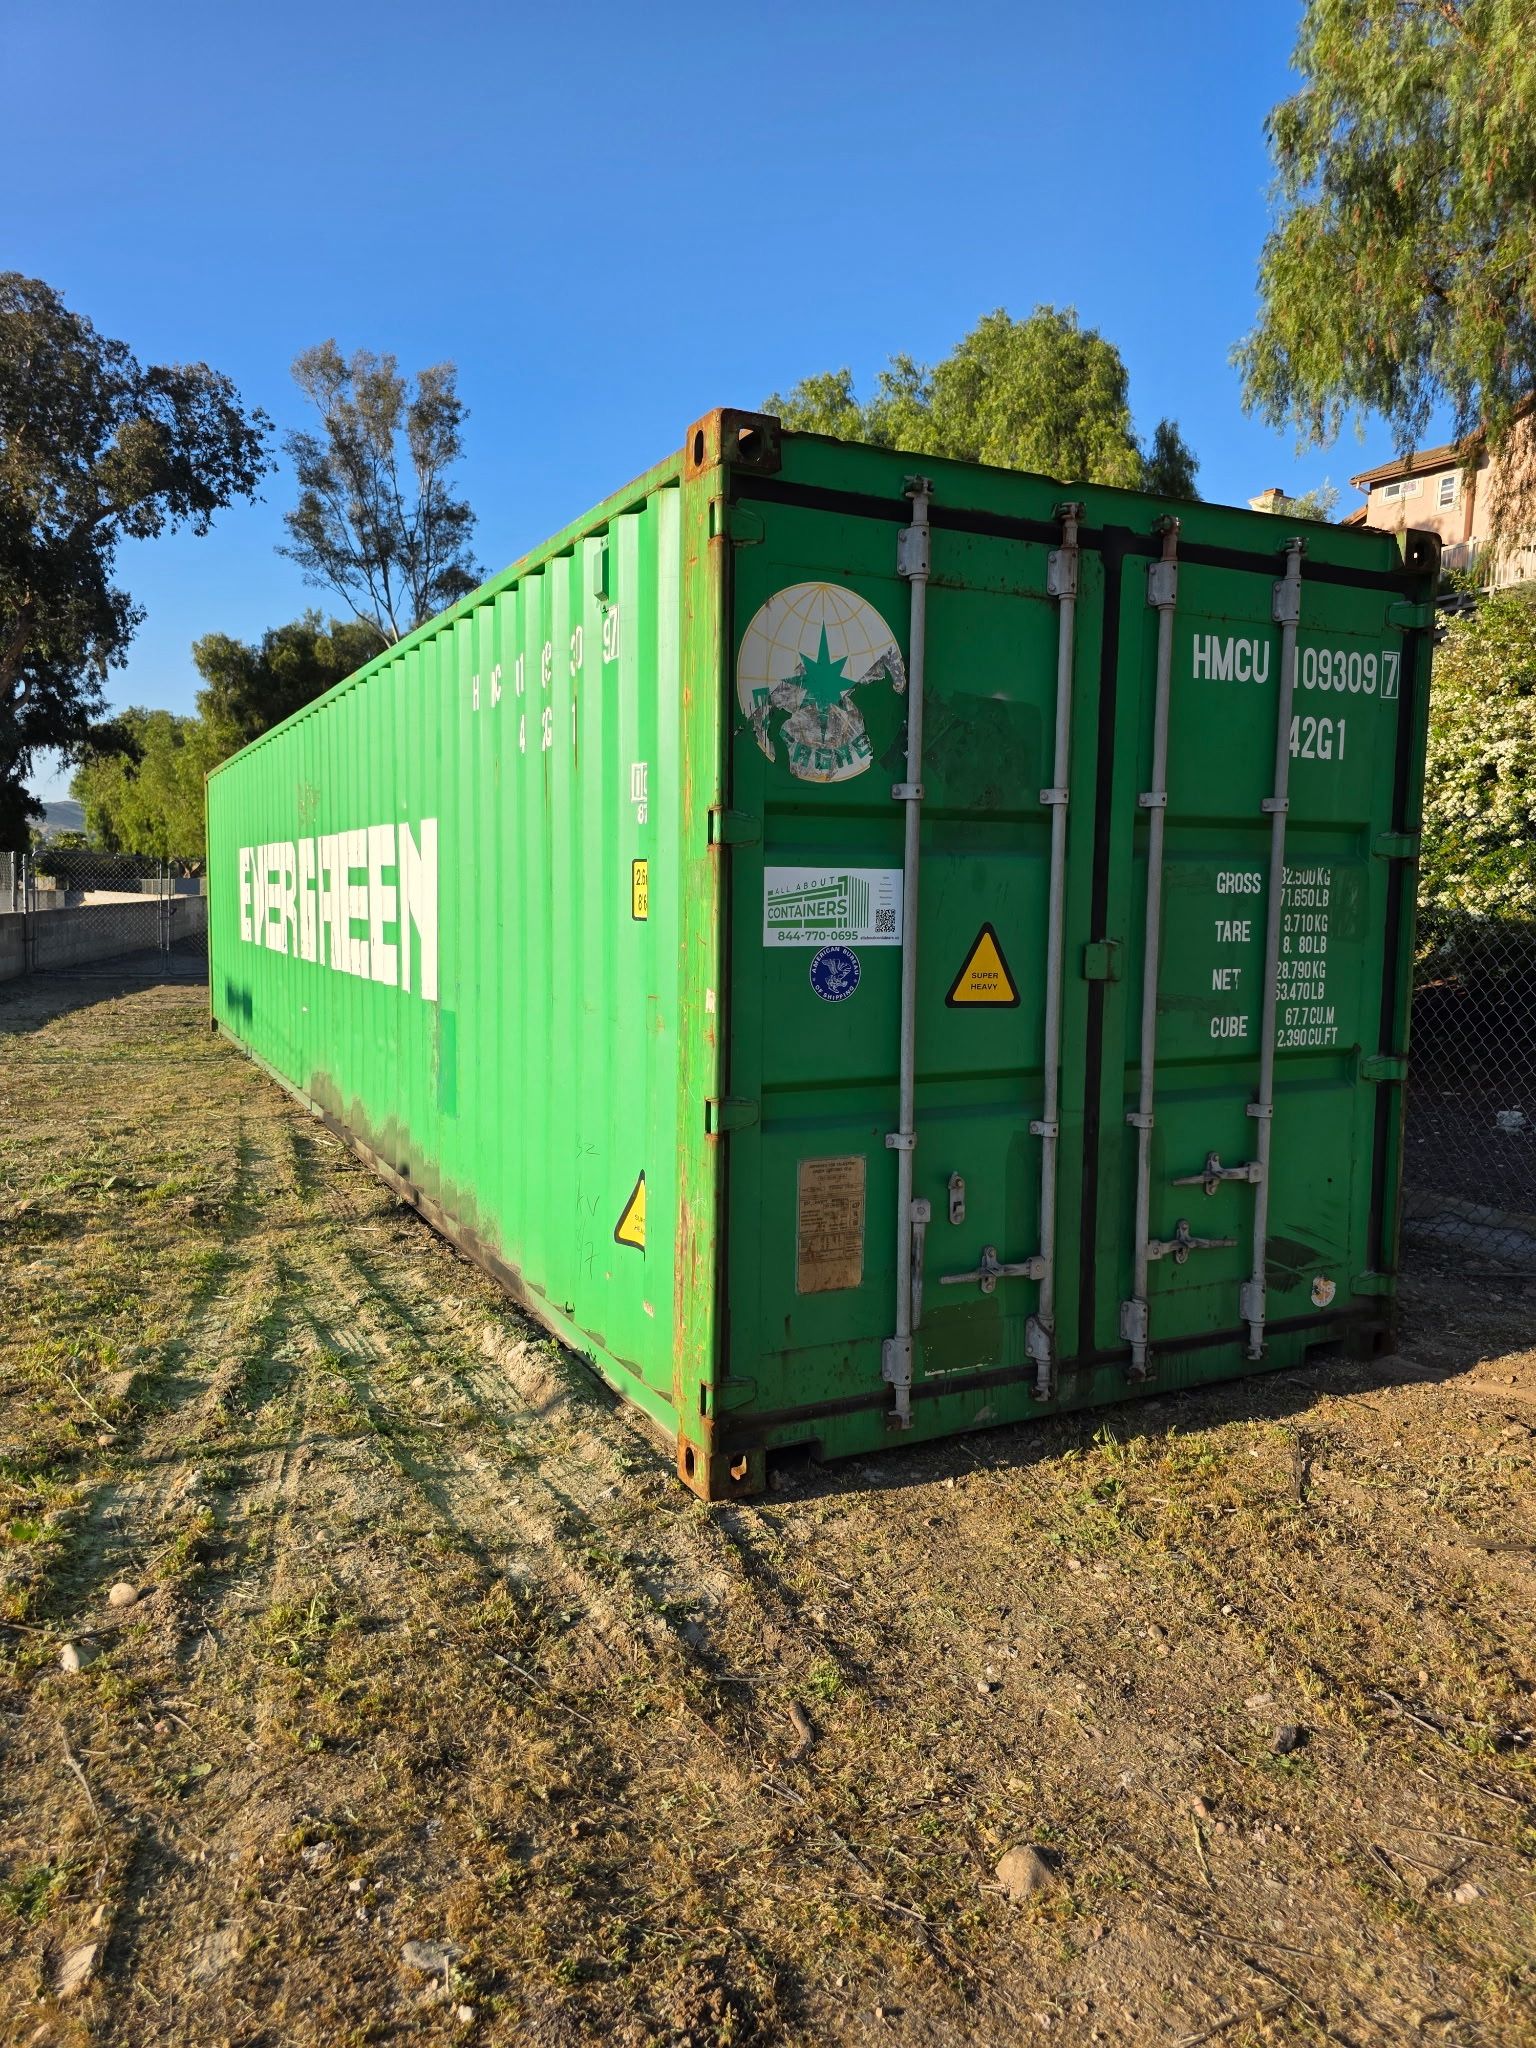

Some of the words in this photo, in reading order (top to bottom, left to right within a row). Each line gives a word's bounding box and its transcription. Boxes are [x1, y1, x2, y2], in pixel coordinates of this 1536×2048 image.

[1193, 634, 1270, 684] HMCU
[1288, 716, 1346, 760] 42G1
[774, 885, 791, 895] ALL
[796, 876, 836, 890] ABOUT
[1216, 871, 1262, 894] GROSS
[767, 898, 848, 919] CONTAINERS
[777, 930, 859, 942] 844-770-0695
[1214, 920, 1252, 942] TARE
[811, 946, 841, 974] AMERICAN
[842, 948, 860, 975] BUREAU
[970, 983, 998, 991] HEAVY
[1211, 968, 1242, 991] NET
[815, 984, 824, 994] OF
[823, 985, 855, 1001] SHIPPING
[1210, 1015, 1249, 1038] CUBE
